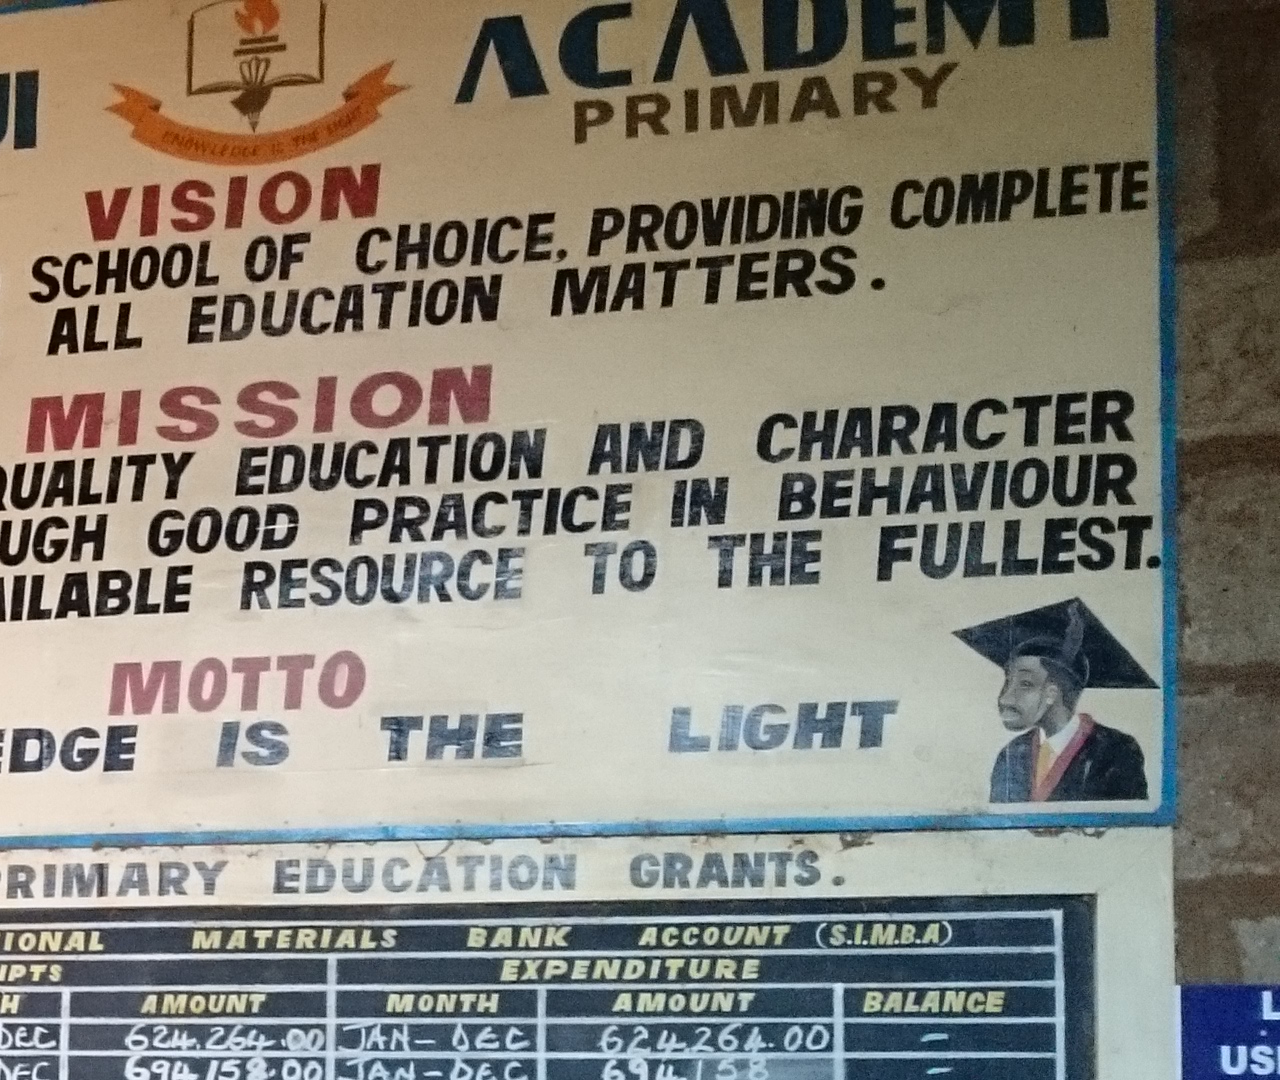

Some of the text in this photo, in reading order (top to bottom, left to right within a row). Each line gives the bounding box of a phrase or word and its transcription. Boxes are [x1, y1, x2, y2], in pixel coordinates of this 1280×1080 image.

[574, 62, 960, 145] PRIMARY
[161, 131, 258, 157] KNOWLEDGE
[30, 241, 220, 305] SCHOOL
[243, 233, 311, 281] OF
[588, 185, 863, 257] PROVIDING
[890, 160, 1149, 230] COMPLETE
[84, 164, 381, 241] VISION
[46, 304, 143, 357] ALL
[186, 276, 502, 346] EDUCATION
[551, 246, 886, 316] MATTERS.
[26, 363, 493, 455] MISSION
[238, 429, 545, 497] EDUCATION
[588, 419, 706, 475] AND
[757, 390, 1135, 464] CHARACTER
[147, 503, 298, 557] GOOD
[349, 485, 632, 546] PRACTICE
[671, 478, 727, 529] IN
[778, 454, 1138, 522] BEHAVIOUR
[241, 545, 527, 611] RESOURCE
[584, 539, 658, 594] TO
[707, 531, 822, 590] THE
[877, 515, 1162, 582] FULLEST.
[109, 651, 366, 717] MOTTO
[215, 720, 291, 768] IS
[380, 712, 525, 762] THE
[668, 700, 899, 753] LIGHT
[273, 851, 578, 896] EDUCATION
[629, 851, 846, 891] GRANTS.
[192, 927, 398, 950] MATERIALS
[467, 927, 573, 948] BANK
[638, 924, 791, 947] ACCOUNT
[500, 957, 761, 982] EXPENDITURE
[140, 994, 267, 1014] AMOUNT
[386, 994, 499, 1013] MONTH
[612, 991, 756, 1014] AMOUNT
[863, 991, 1005, 1013] BALANCE
